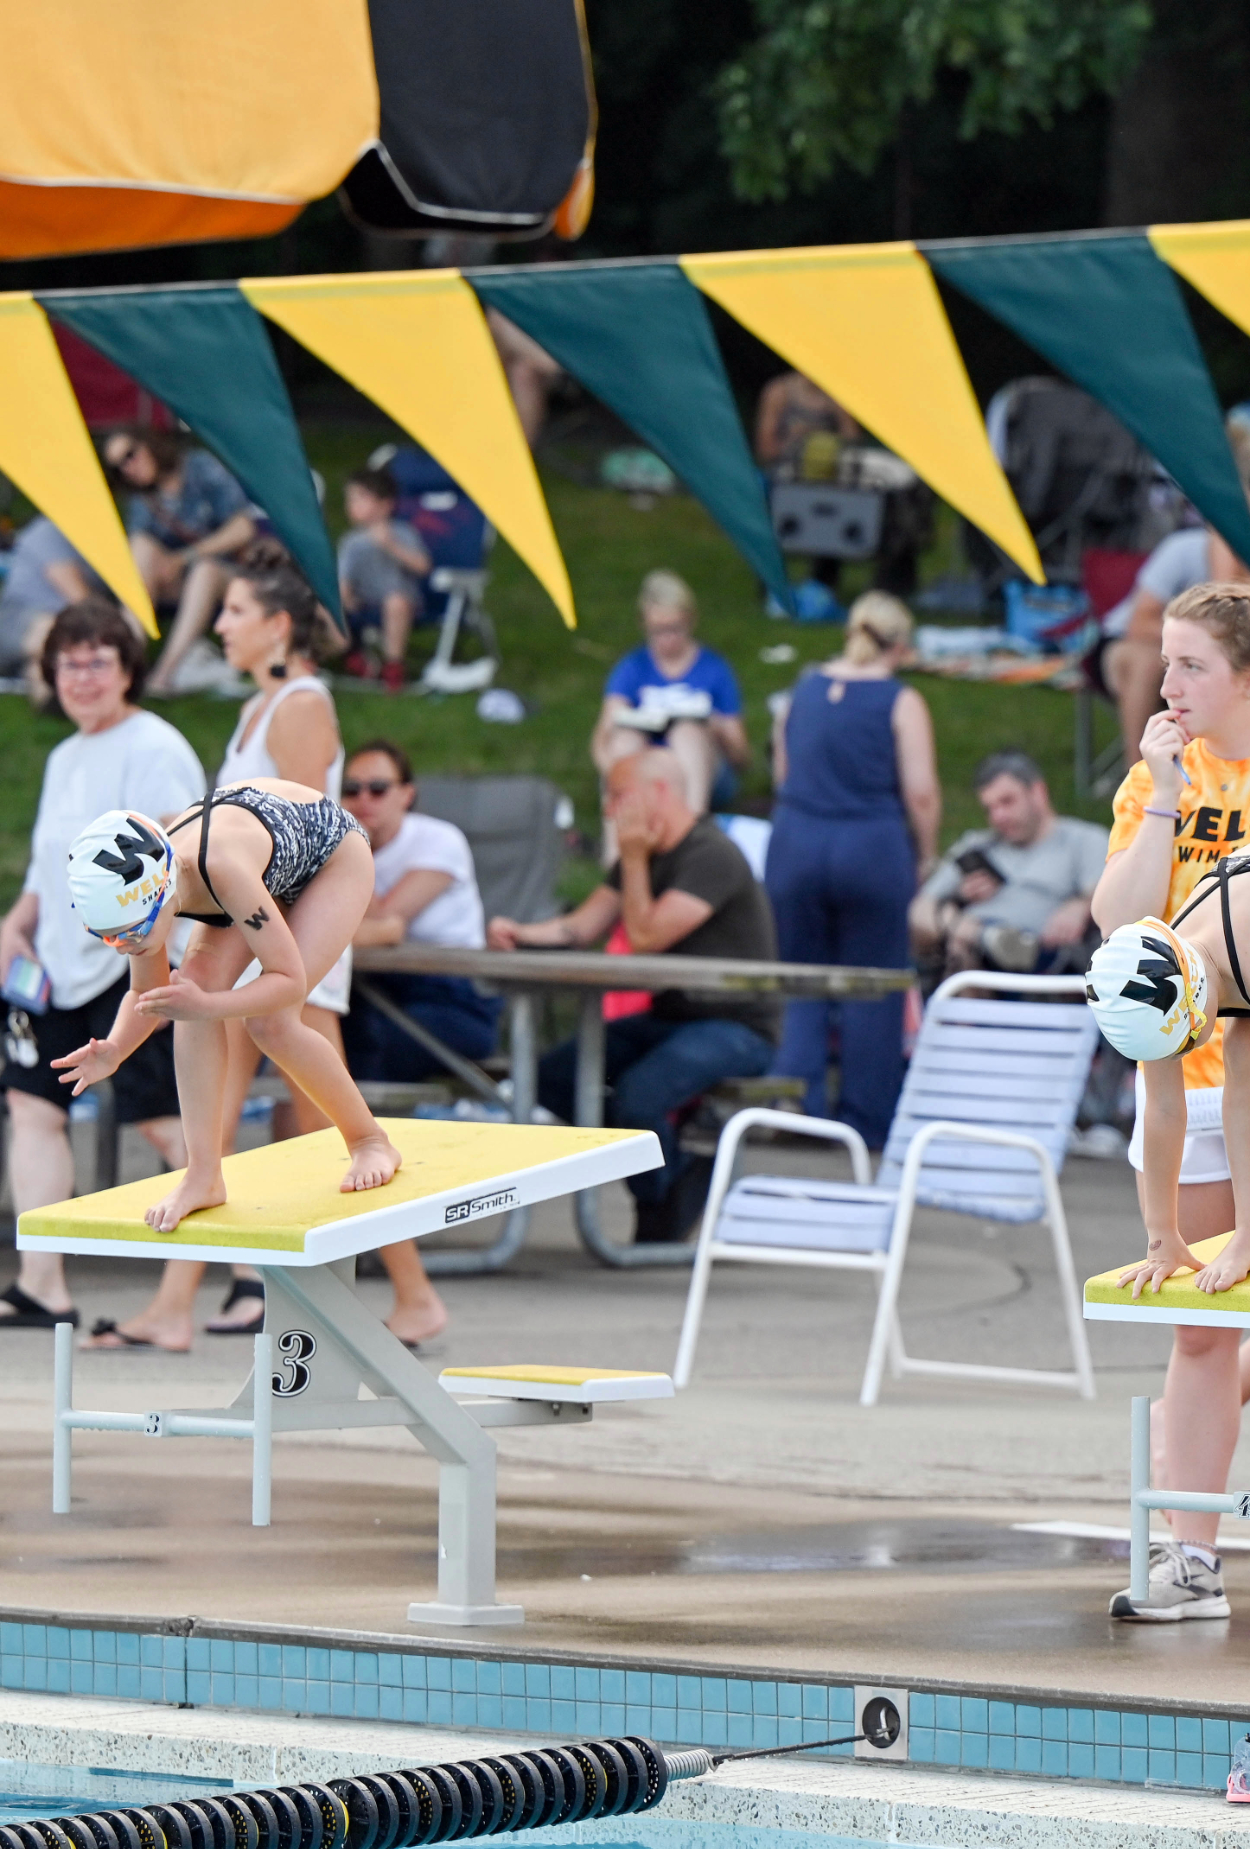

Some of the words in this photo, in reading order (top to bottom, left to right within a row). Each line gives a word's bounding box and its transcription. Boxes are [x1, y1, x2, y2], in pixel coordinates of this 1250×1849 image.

[91, 815, 166, 886] W
[244, 905, 270, 931] W
[271, 1329, 317, 1398] 3
[145, 1413, 160, 1434] 3
